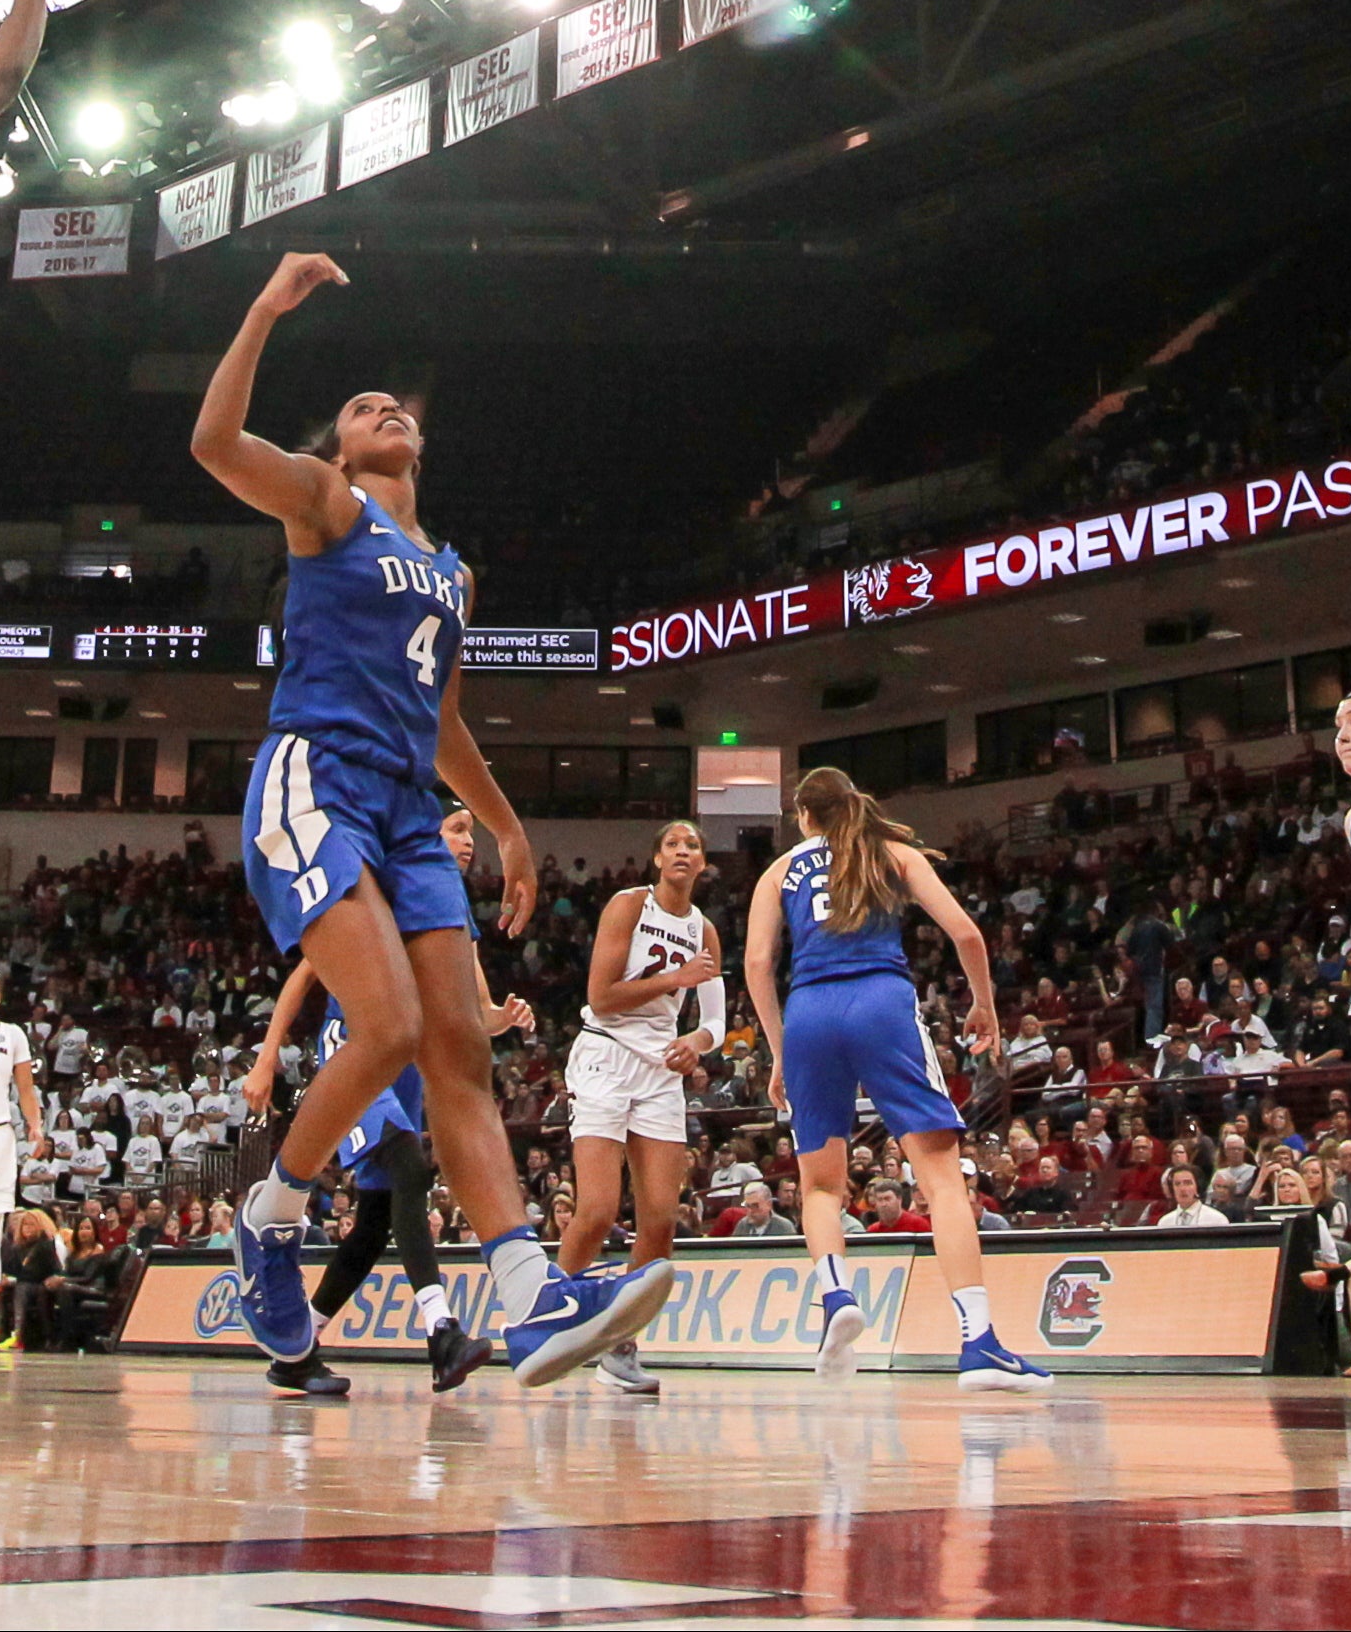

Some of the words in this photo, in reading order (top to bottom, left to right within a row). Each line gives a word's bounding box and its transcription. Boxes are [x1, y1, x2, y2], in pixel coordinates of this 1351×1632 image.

[476, 47, 511, 85] SEC
[370, 96, 401, 132] SEC
[271, 140, 302, 174] SEC
[175, 176, 216, 214] NCAA
[273, 187, 296, 208] 2016
[53, 211, 96, 237] SEC
[44, 256, 97, 272] 2016-17
[963, 491, 1231, 597] FOREVER
[406, 615, 442, 686] 4
[476, 651, 513, 662] twice
[517, 650, 542, 662] this
[546, 653, 594, 663] season
[488, 634, 536, 646] named
[541, 635, 569, 646] SEC
